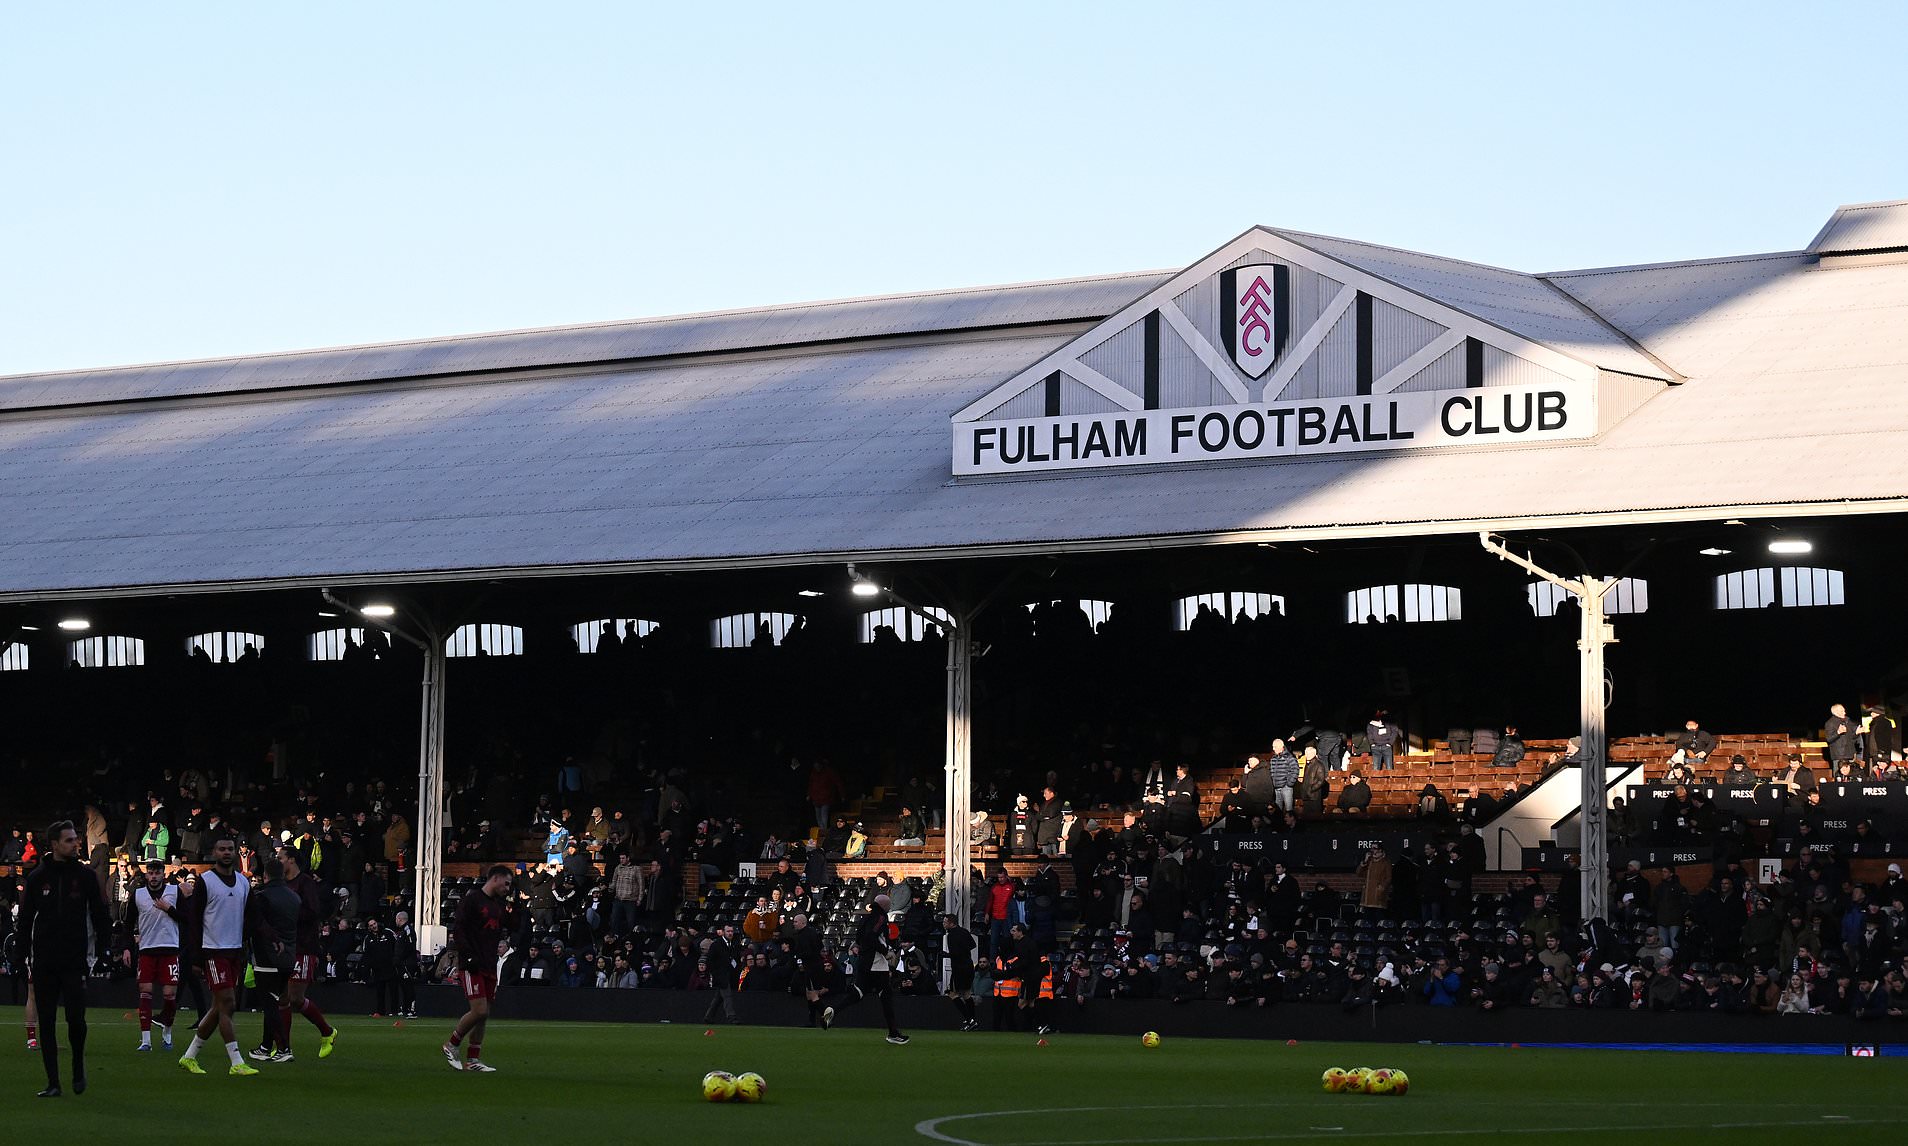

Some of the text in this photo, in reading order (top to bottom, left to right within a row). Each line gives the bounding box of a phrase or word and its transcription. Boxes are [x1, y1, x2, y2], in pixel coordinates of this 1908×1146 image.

[1239, 275, 1271, 357] FFC
[973, 391, 1567, 466] FULHAM FOOTBALL CLUB
[1730, 790, 1754, 799] PRESS
[1862, 787, 1887, 796] PRESS
[1823, 820, 1847, 829] PRESS
[1238, 841, 1263, 850] PRESS
[1358, 840, 1383, 849] PRE
[1673, 853, 1697, 862] PRESS
[167, 964, 178, 976] 12
